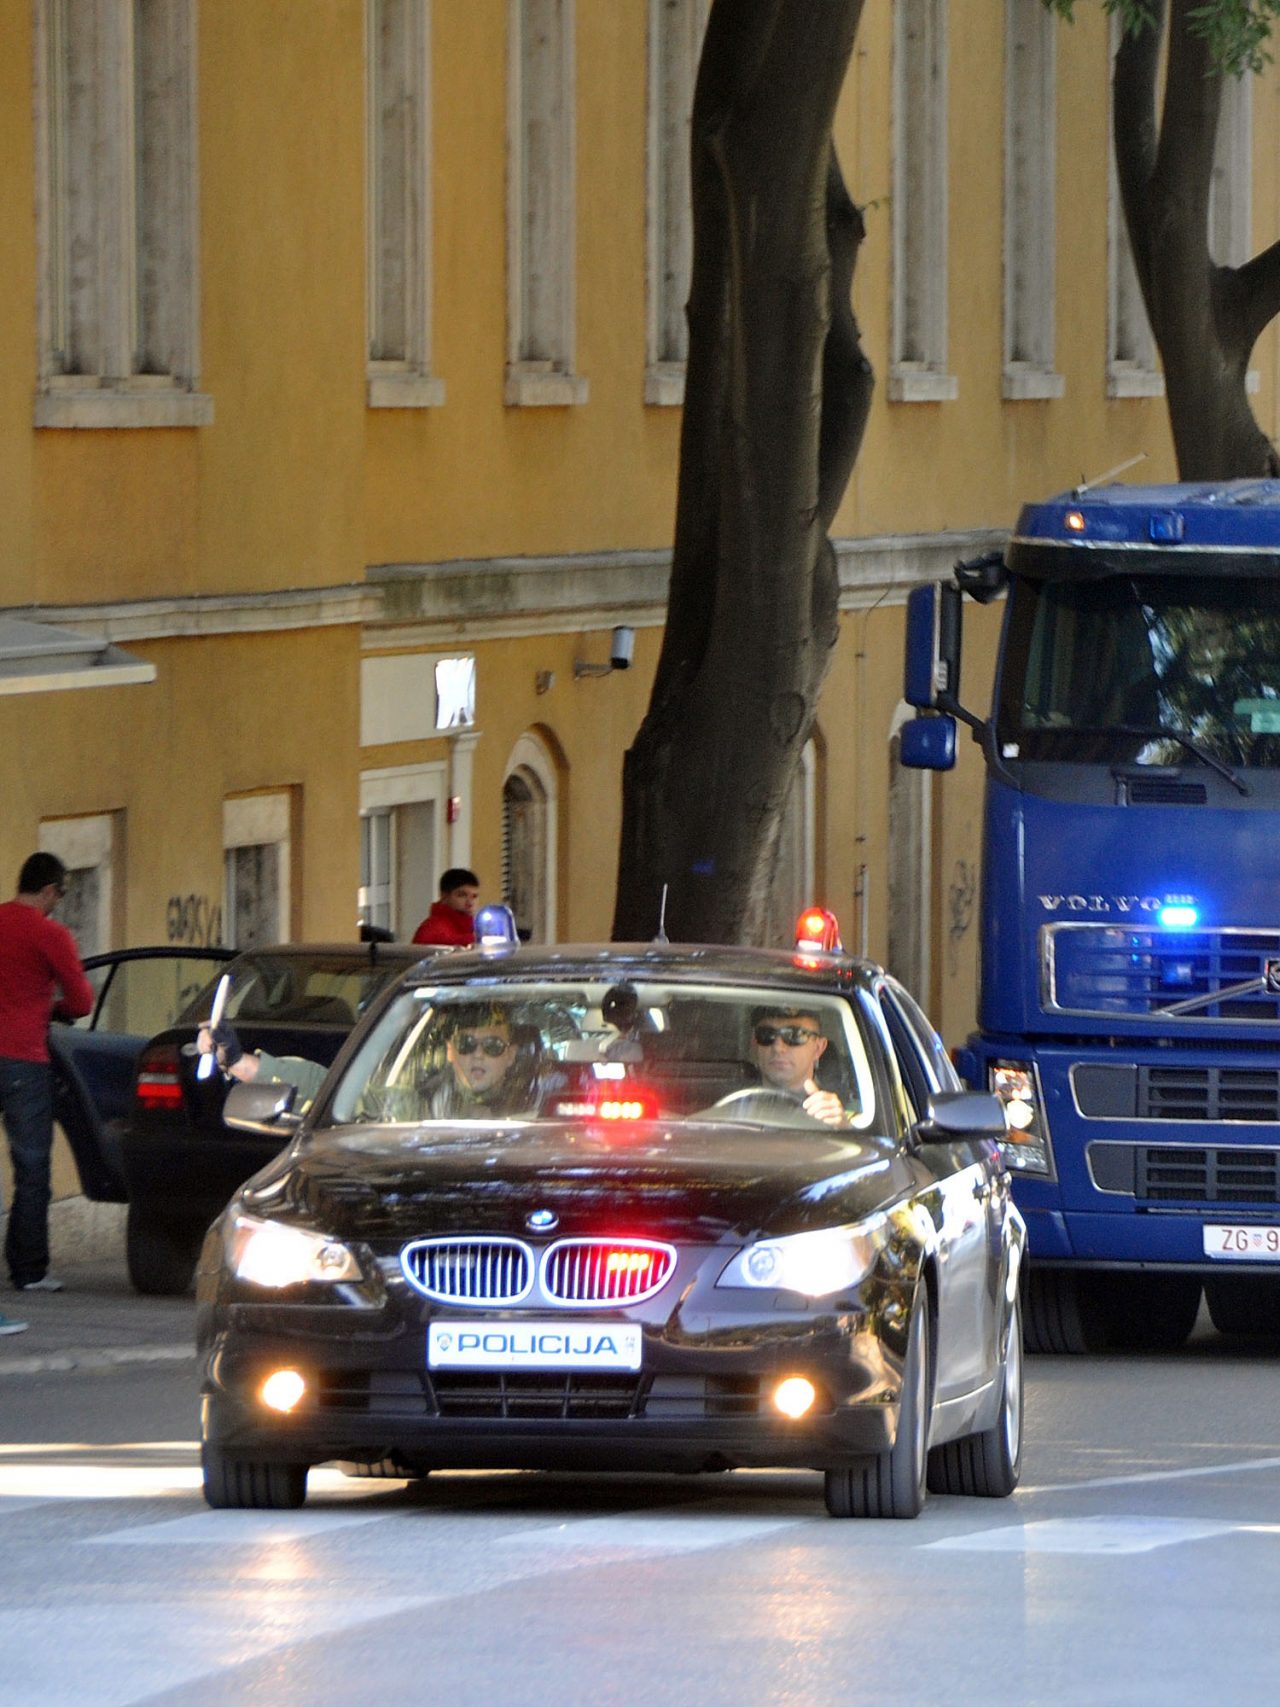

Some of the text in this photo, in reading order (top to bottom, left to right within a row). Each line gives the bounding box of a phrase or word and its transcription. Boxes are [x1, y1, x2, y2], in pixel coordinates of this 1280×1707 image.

[1038, 895, 1162, 911] VOLVO
[1222, 1229, 1248, 1251] ZG
[457, 1333, 618, 1355] POLICIJA
